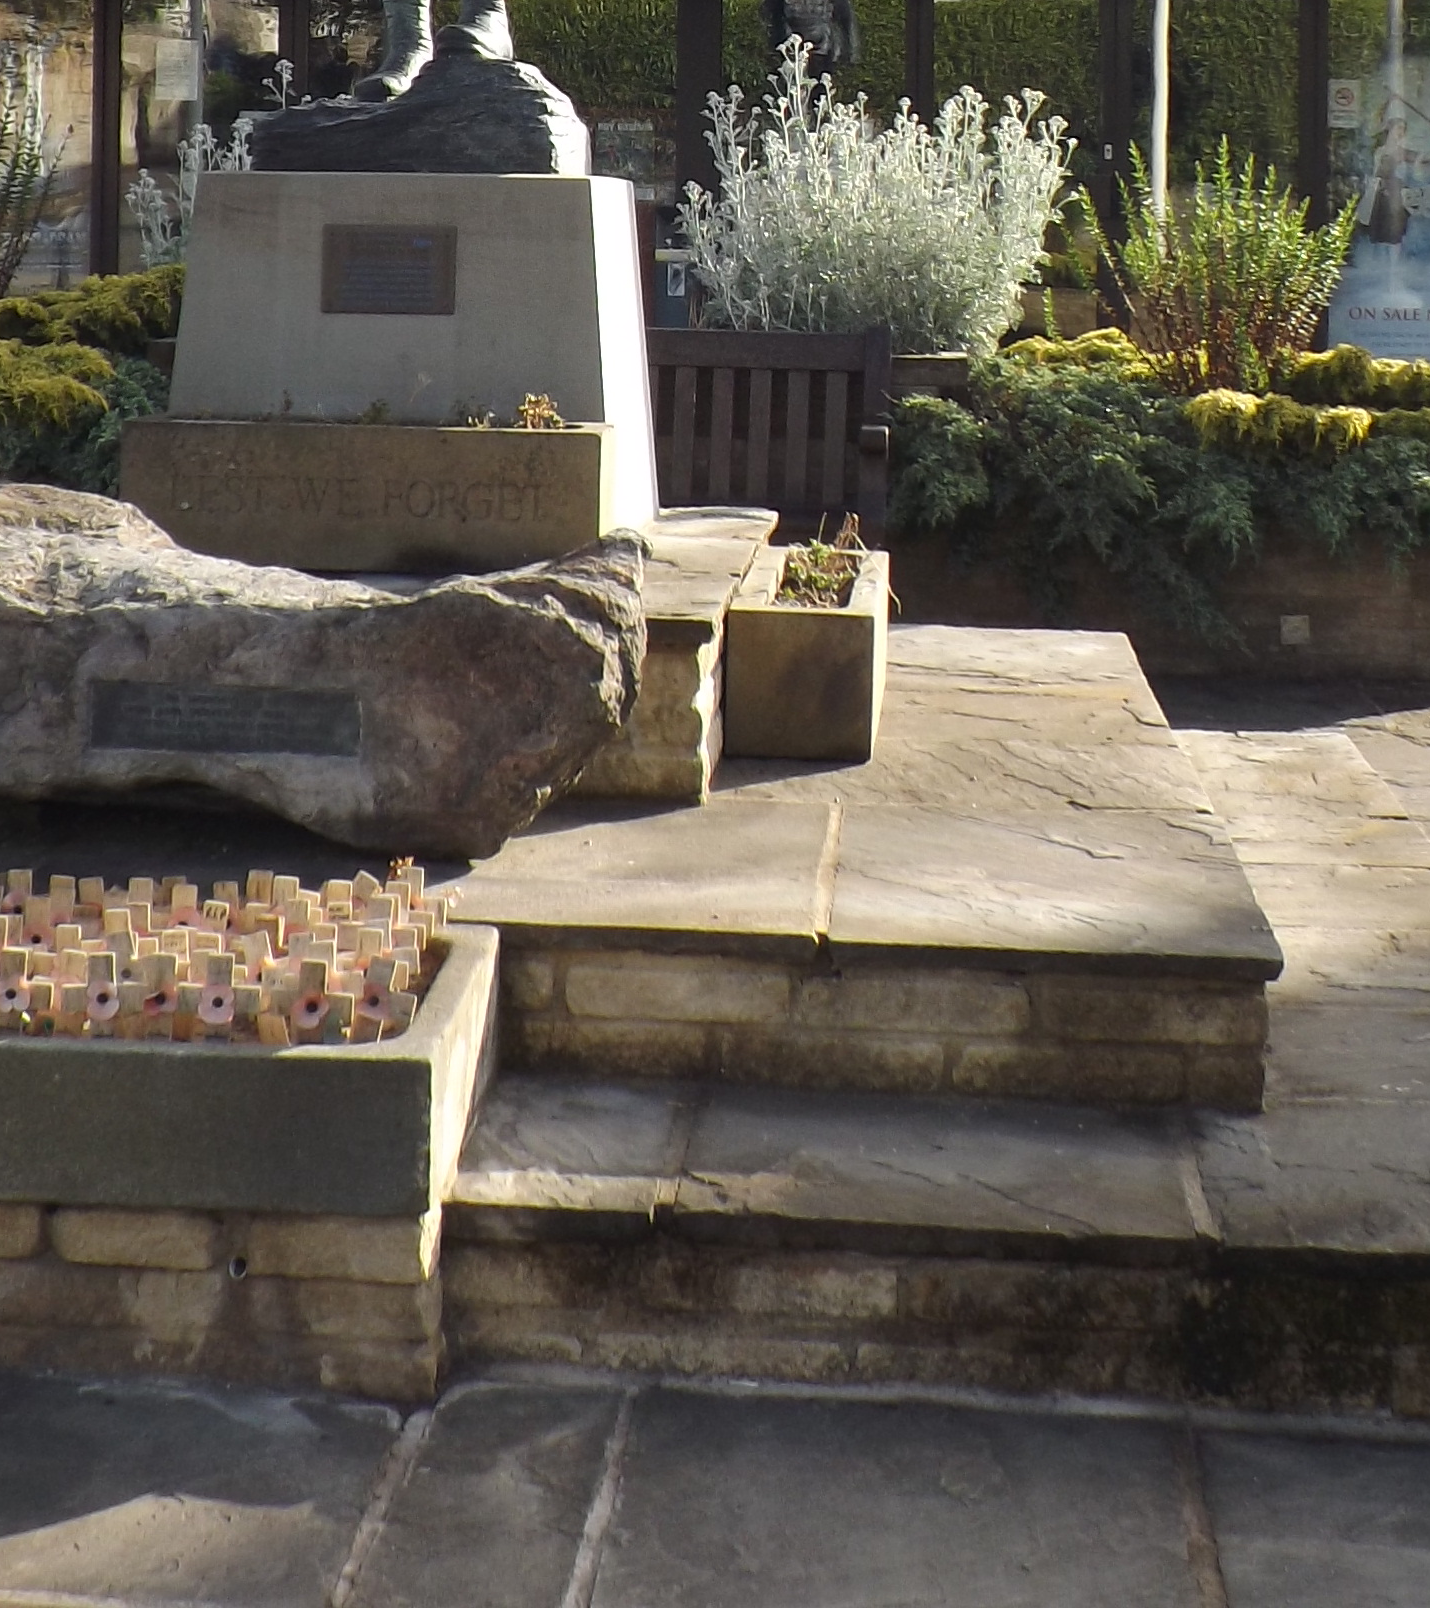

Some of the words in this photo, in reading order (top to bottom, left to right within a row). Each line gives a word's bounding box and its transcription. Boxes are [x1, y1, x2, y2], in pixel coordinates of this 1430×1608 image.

[1349, 306, 1376, 320] ON
[1383, 307, 1420, 321] SALE
[292, 477, 359, 518] WE
[382, 479, 544, 522] FORGET
